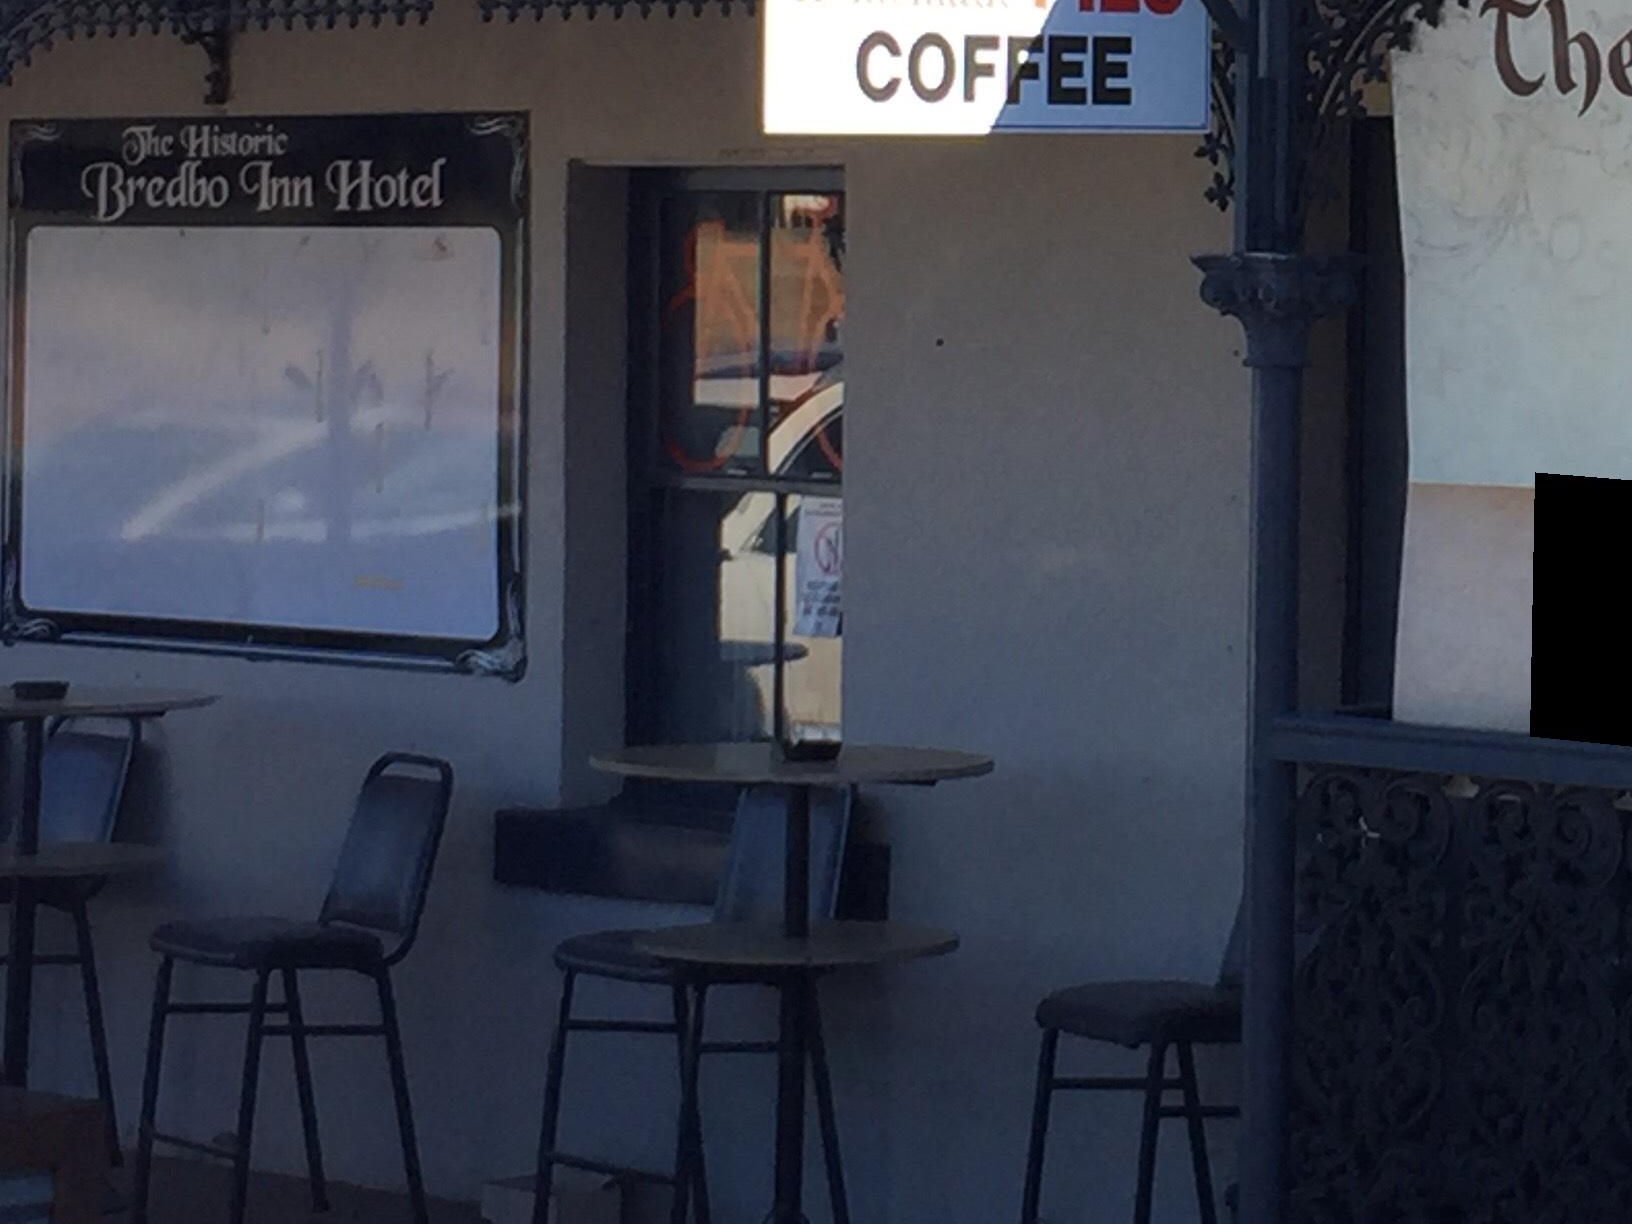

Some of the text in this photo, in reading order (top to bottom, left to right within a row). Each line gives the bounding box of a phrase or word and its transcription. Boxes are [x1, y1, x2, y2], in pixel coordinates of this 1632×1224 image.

[855, 29, 1133, 106] COFFEE
[122, 123, 289, 166] The Historic
[81, 157, 447, 222] Bredbo Inn Hotel
